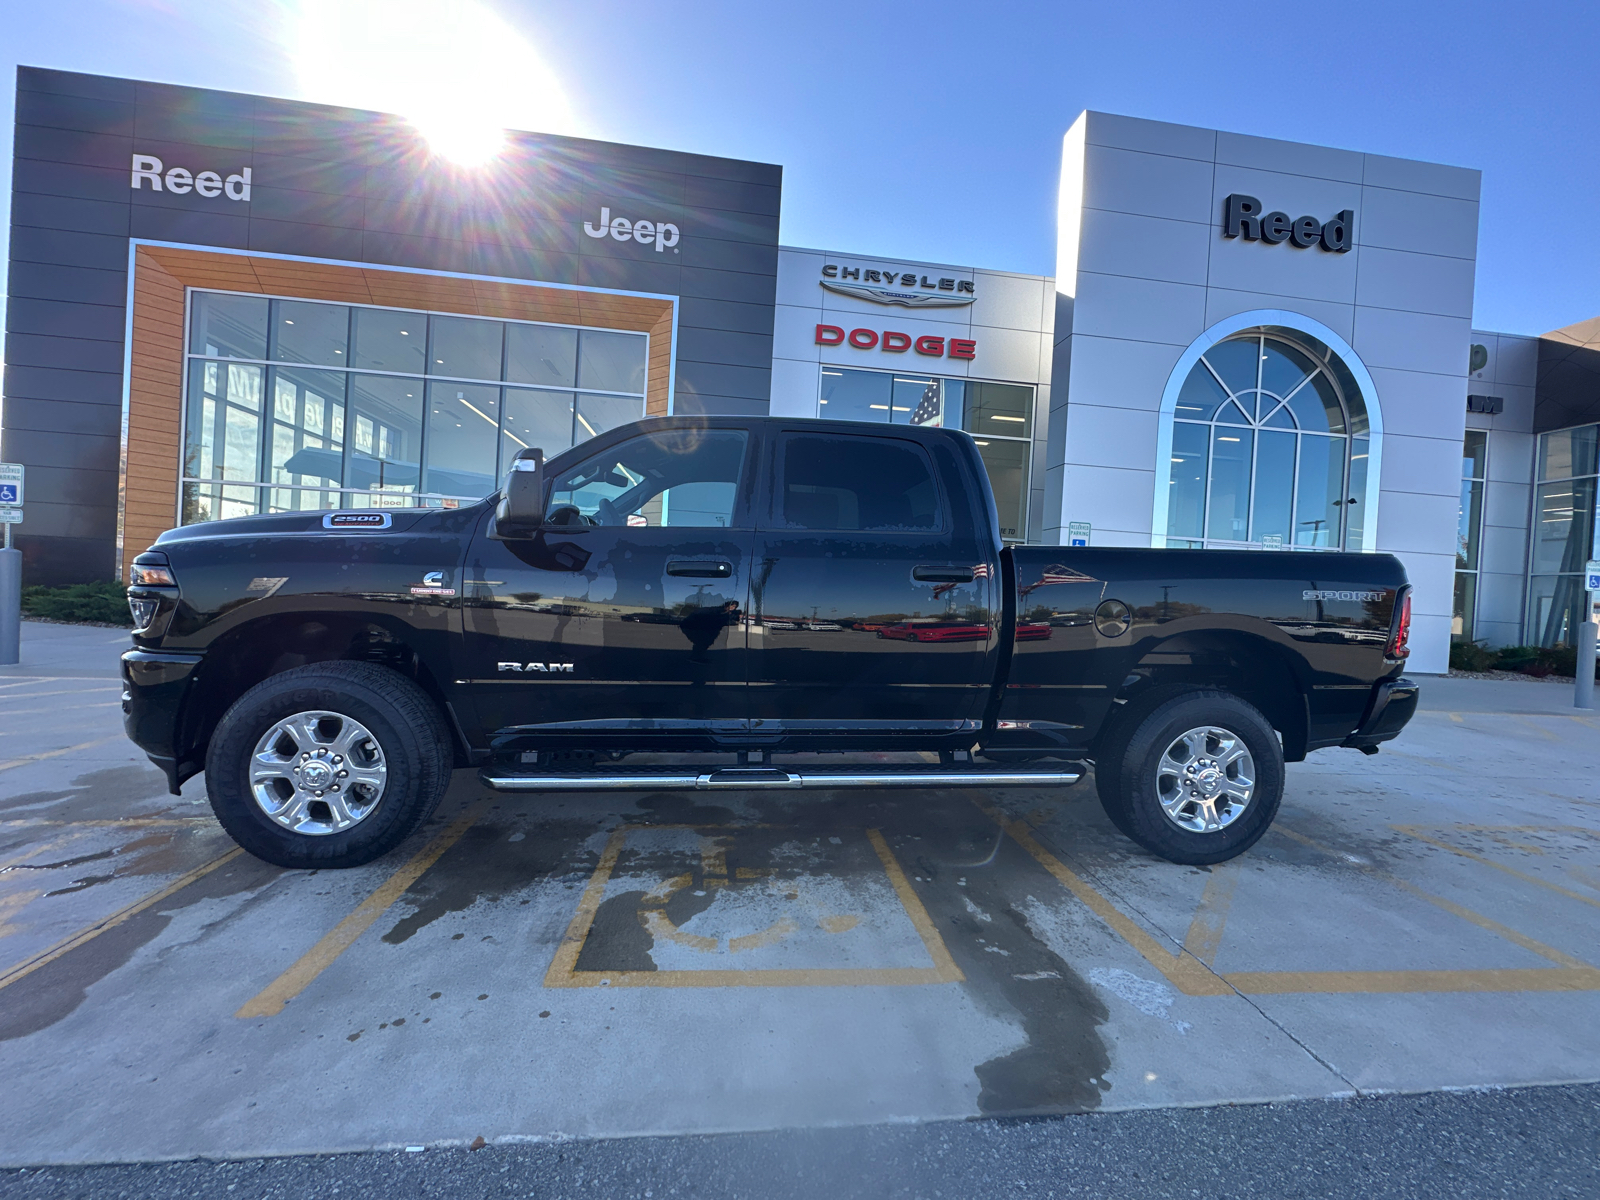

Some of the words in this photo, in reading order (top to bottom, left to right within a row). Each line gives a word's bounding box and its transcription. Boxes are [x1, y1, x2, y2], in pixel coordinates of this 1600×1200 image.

[131, 153, 252, 202] Reed
[583, 206, 680, 253] Jeep
[1224, 193, 1354, 254] Reed
[822, 264, 975, 293] CHRYSLER
[815, 323, 977, 360] DODGE
[1302, 590, 1387, 602] SPORT
[498, 661, 574, 673] RAM
